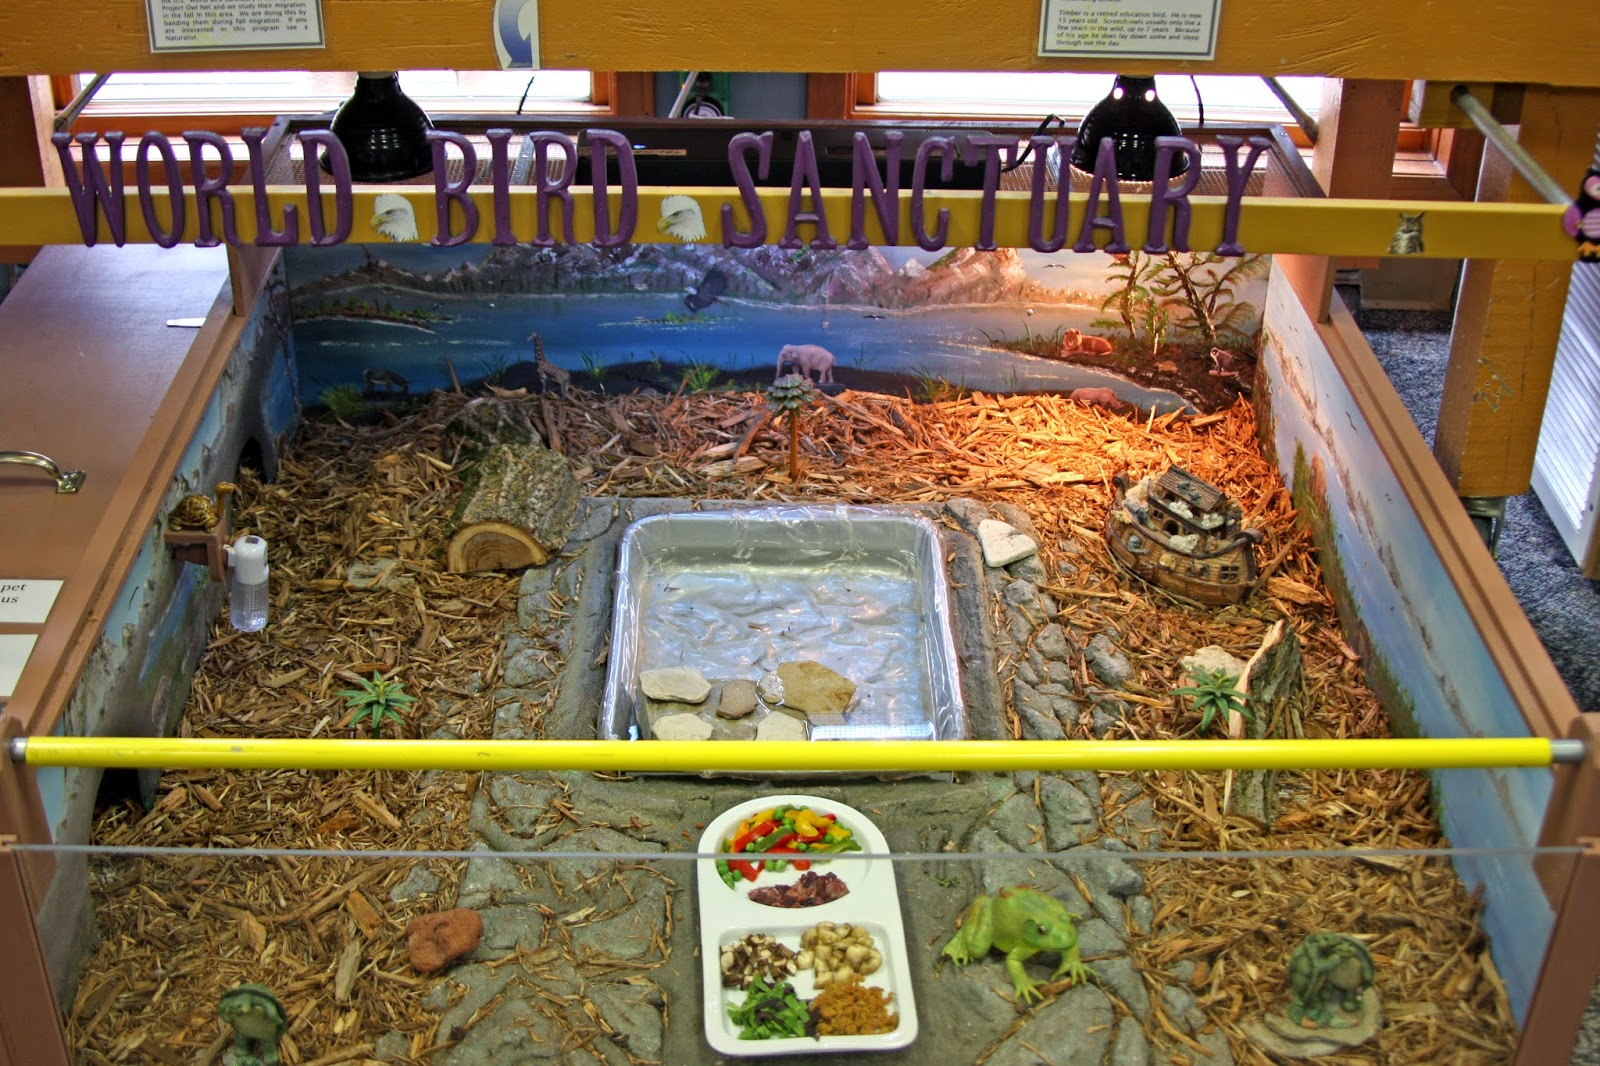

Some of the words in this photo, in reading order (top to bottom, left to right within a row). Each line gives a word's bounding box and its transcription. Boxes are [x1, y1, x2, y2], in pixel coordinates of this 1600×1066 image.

[51, 127, 353, 248] WORLD
[426, 128, 638, 248] BIRD
[721, 129, 1271, 257] SANCTUARY
[0, 584, 26, 592] pet
